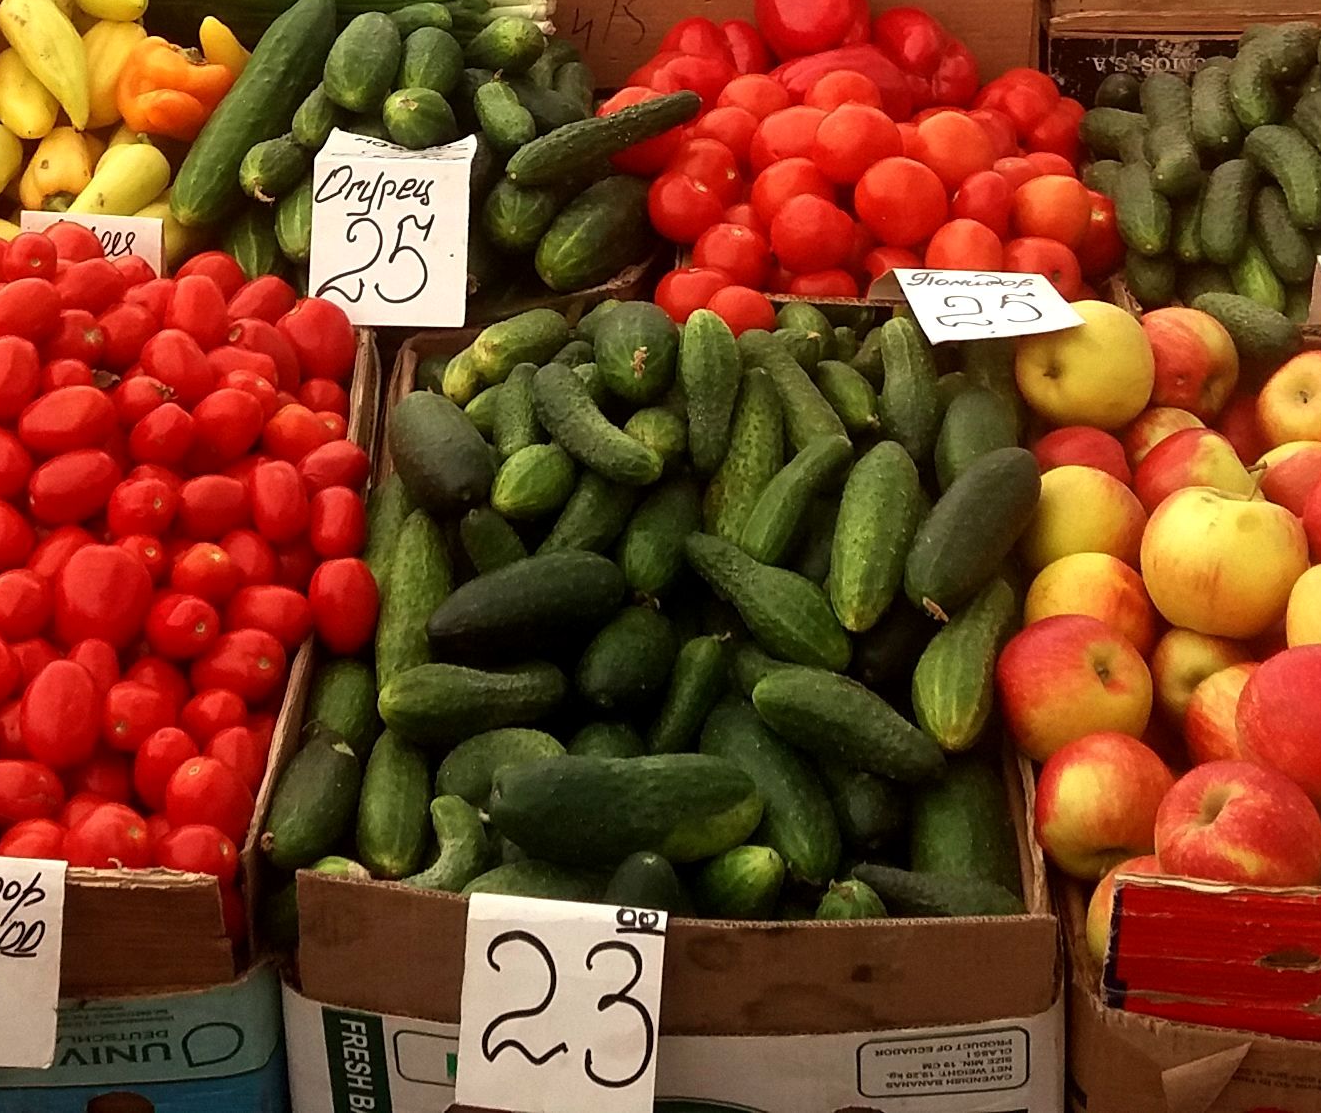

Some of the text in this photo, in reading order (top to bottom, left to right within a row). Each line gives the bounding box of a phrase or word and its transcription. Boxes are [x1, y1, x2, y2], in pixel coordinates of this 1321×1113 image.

[315, 165, 435, 217] Огурец
[315, 214, 436, 304] 25
[936, 292, 1043, 329] 25
[482, 929, 655, 1088] 23
[340, 1018, 376, 1088] FRESH
[875, 1038, 1013, 1057] PRODUCT OF ECUADOR
[974, 1047, 1013, 1057] CLASS
[988, 1056, 1013, 1064] SIZE
[886, 1074, 1013, 1089] CAVENDISH BANANAS
